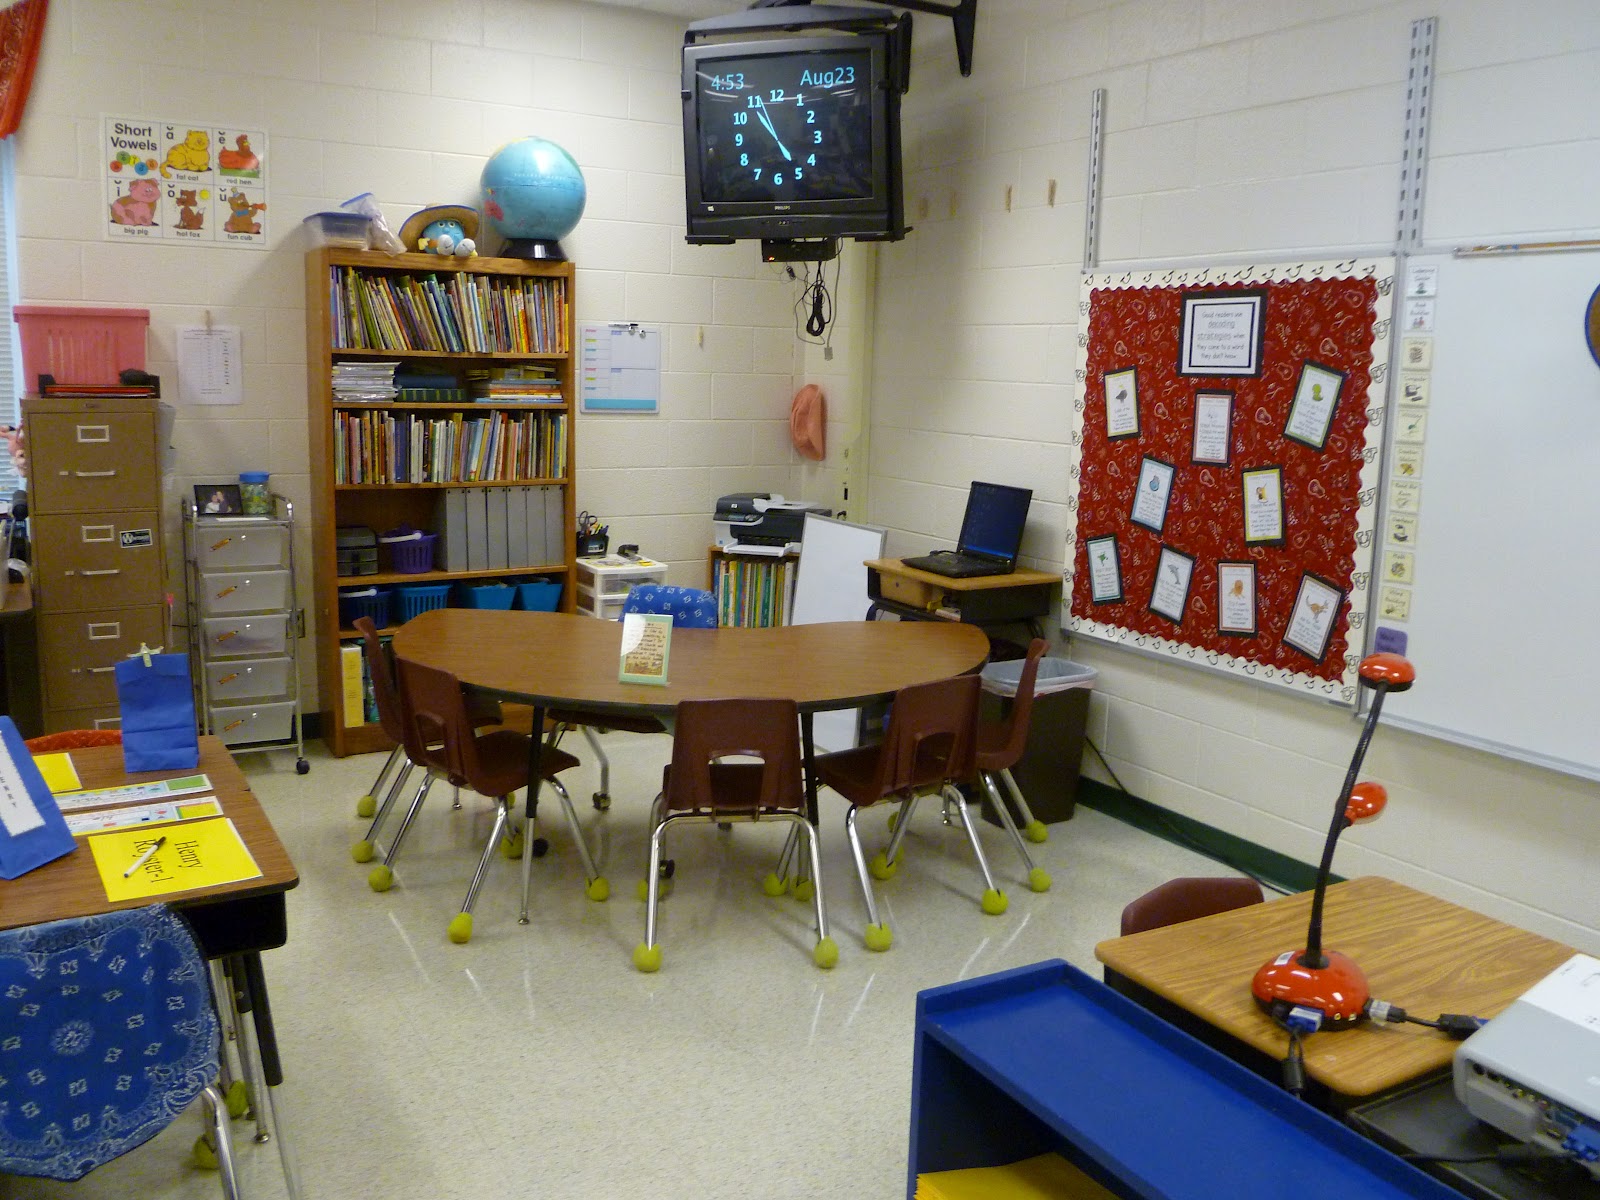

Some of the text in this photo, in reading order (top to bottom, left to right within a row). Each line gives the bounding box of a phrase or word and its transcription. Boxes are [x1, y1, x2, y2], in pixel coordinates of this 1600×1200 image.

[711, 73, 745, 91] 4:53
[800, 66, 855, 89] Aug23
[747, 95, 762, 108] 11
[769, 89, 785, 103] 12
[796, 93, 804, 107] 1
[733, 112, 748, 125] 10
[806, 110, 815, 124] 2
[114, 123, 152, 137] Short
[110, 136, 158, 151] Vowels
[735, 133, 744, 146] 9
[813, 130, 822, 144] 3
[740, 153, 749, 166] 8
[806, 153, 816, 166] 4
[187, 174, 199, 182] cat
[753, 168, 762, 181] 7
[773, 173, 783, 185] 6
[794, 167, 803, 180] 5
[239, 178, 252, 186] hen
[124, 227, 149, 236] big pig
[174, 840, 203, 869] Henry
